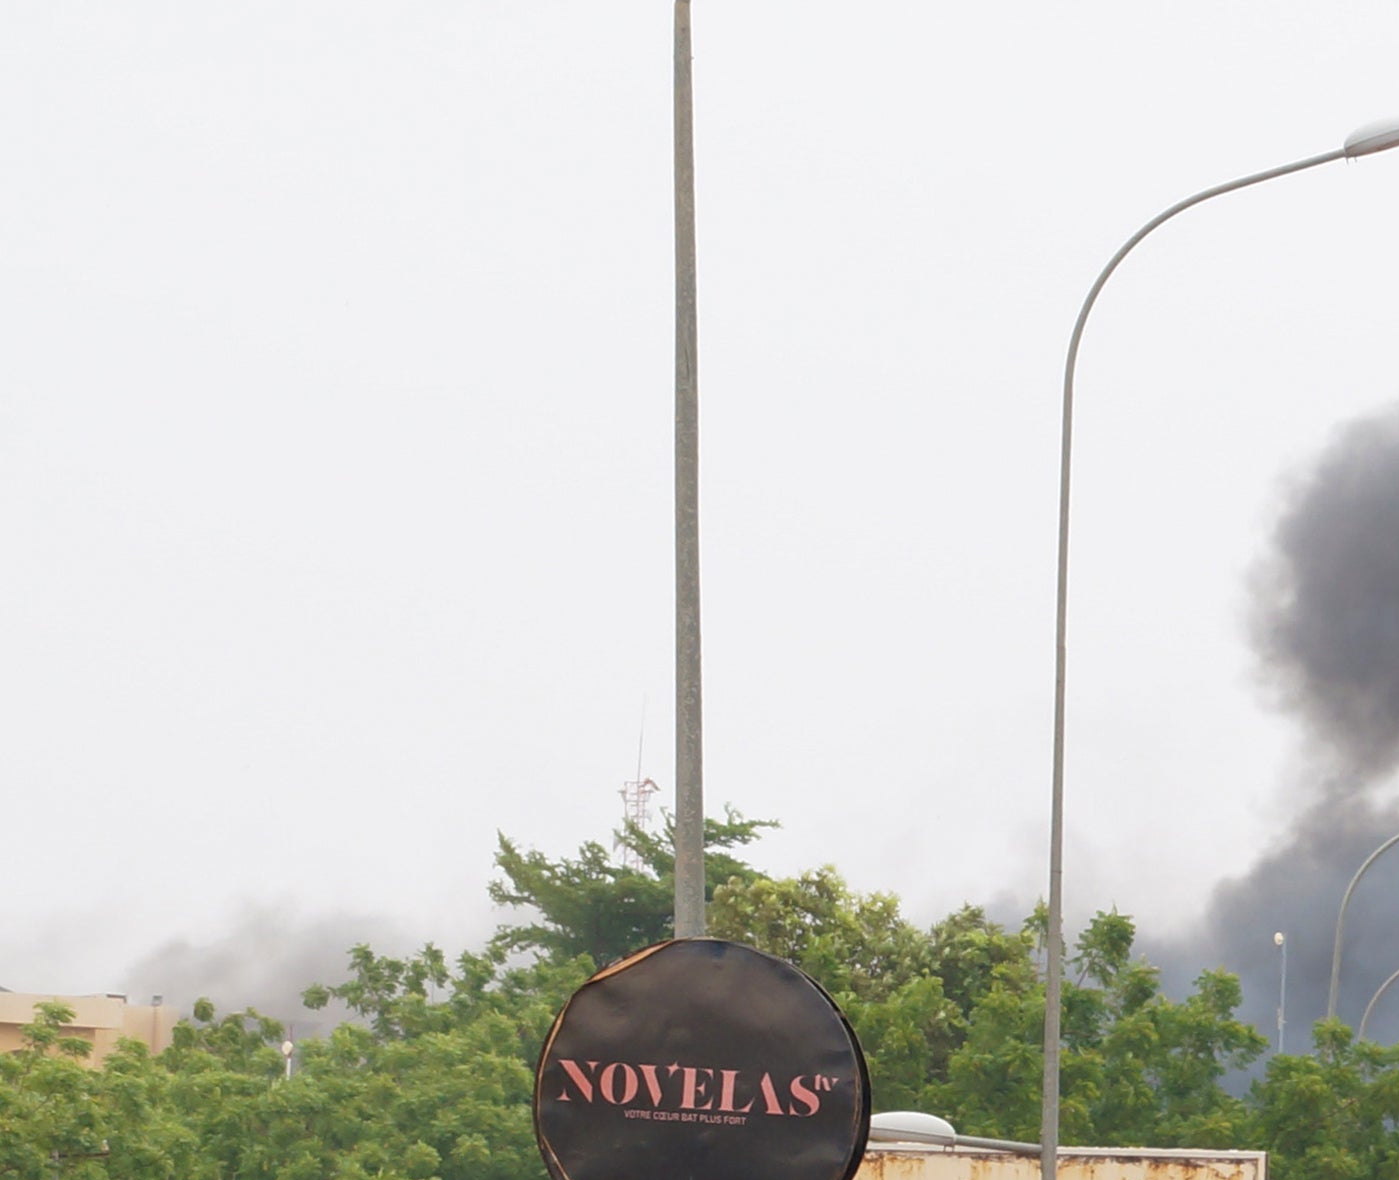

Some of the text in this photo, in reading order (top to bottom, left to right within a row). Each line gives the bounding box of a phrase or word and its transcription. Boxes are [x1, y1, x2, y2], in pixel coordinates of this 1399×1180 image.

[557, 1058, 820, 1118] NOVELAS
[624, 1109, 651, 1121] VOTRE
[681, 1112, 698, 1123] BAT
[699, 1113, 723, 1125] PLUS
[723, 1114, 747, 1126] FORT
